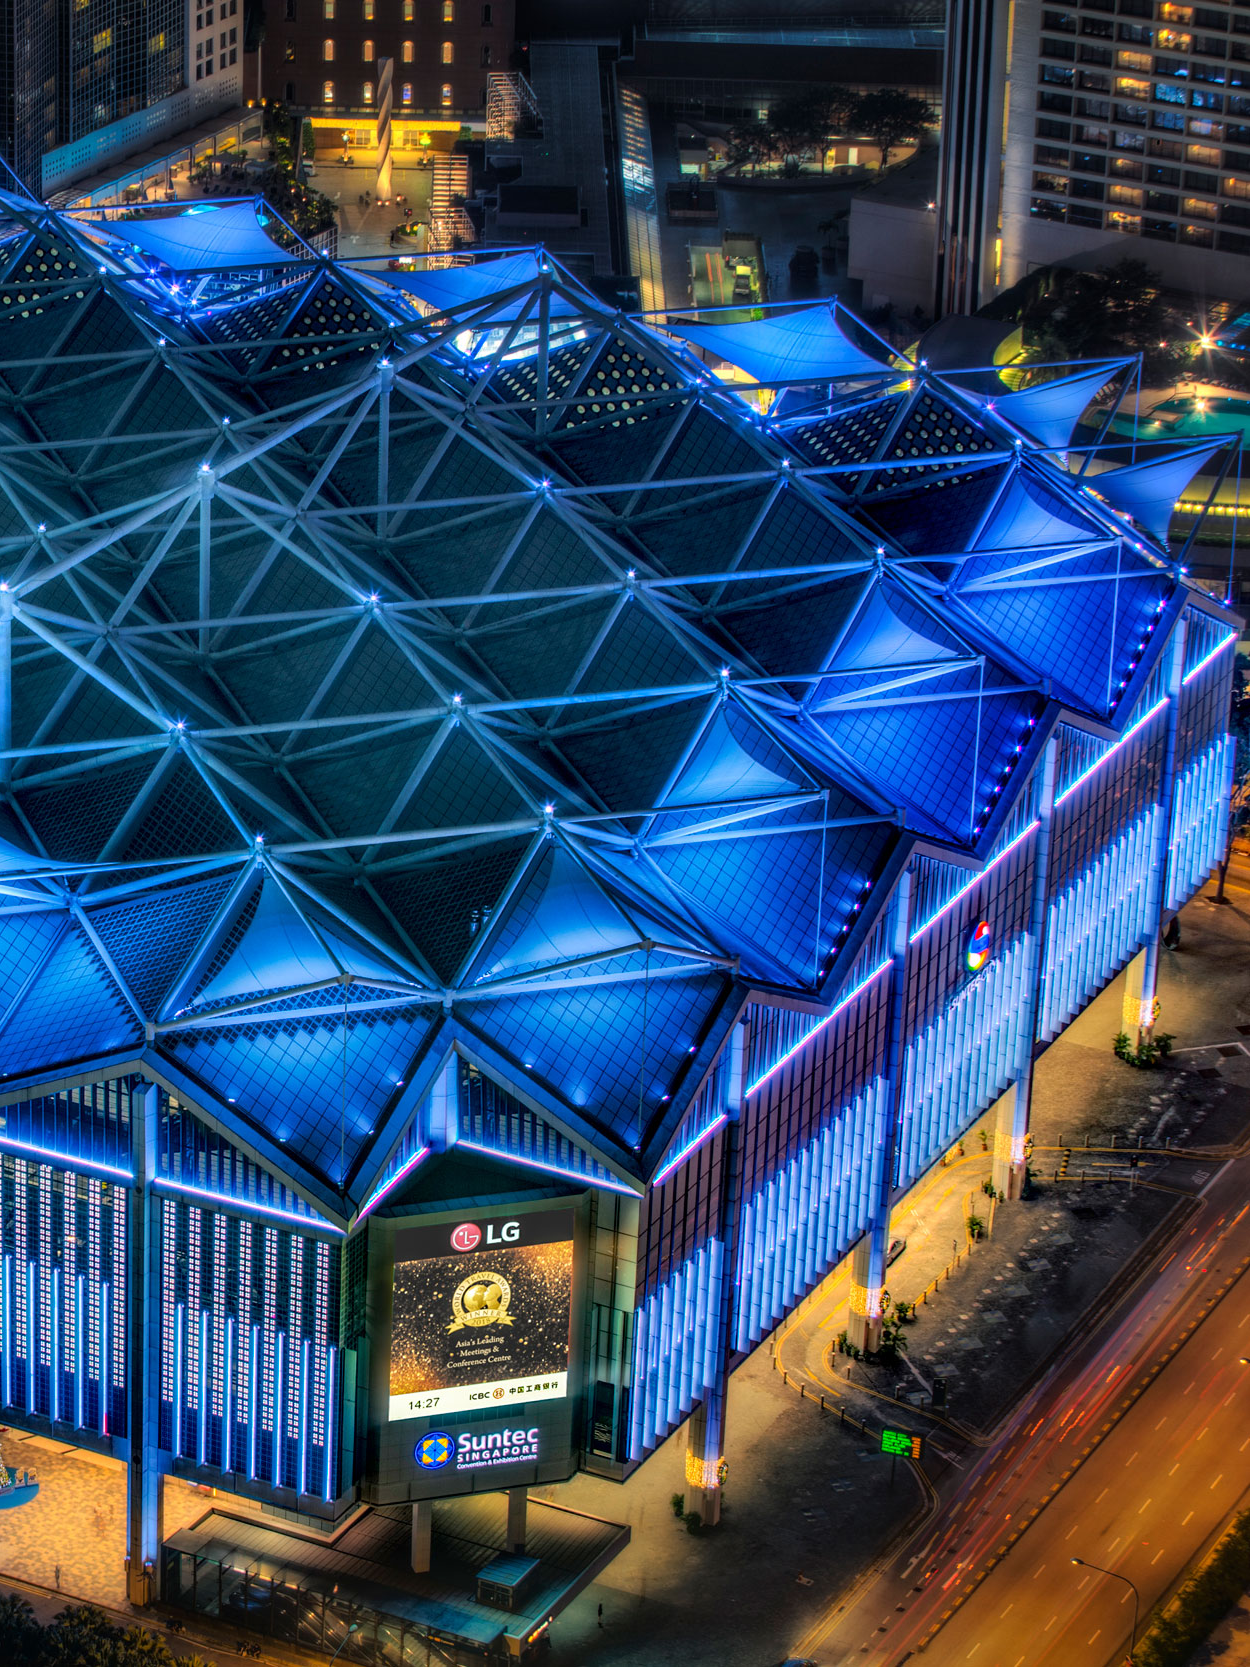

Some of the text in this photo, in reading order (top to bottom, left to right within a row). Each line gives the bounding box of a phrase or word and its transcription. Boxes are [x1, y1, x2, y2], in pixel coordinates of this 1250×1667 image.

[486, 1221, 520, 1245] LG
[453, 1273, 510, 1315] WORLD TRAVEL AWARDS
[460, 1309, 503, 1321] WINNER
[471, 1318, 491, 1326] 2018
[455, 1336, 505, 1348] Asia's Leading
[459, 1345, 500, 1357] Meetings &
[446, 1354, 512, 1369] Conference Centre
[509, 1381, 558, 1395] 中国工商银行
[469, 1391, 490, 1401] ICBC
[408, 1397, 440, 1410] 14:27
[457, 1427, 539, 1453] Suntec
[456, 1444, 539, 1463] SINGAPORE
[456, 1460, 487, 1470] Convention
[493, 1456, 519, 1465] Exhibition
[519, 1454, 538, 1462] Centre
